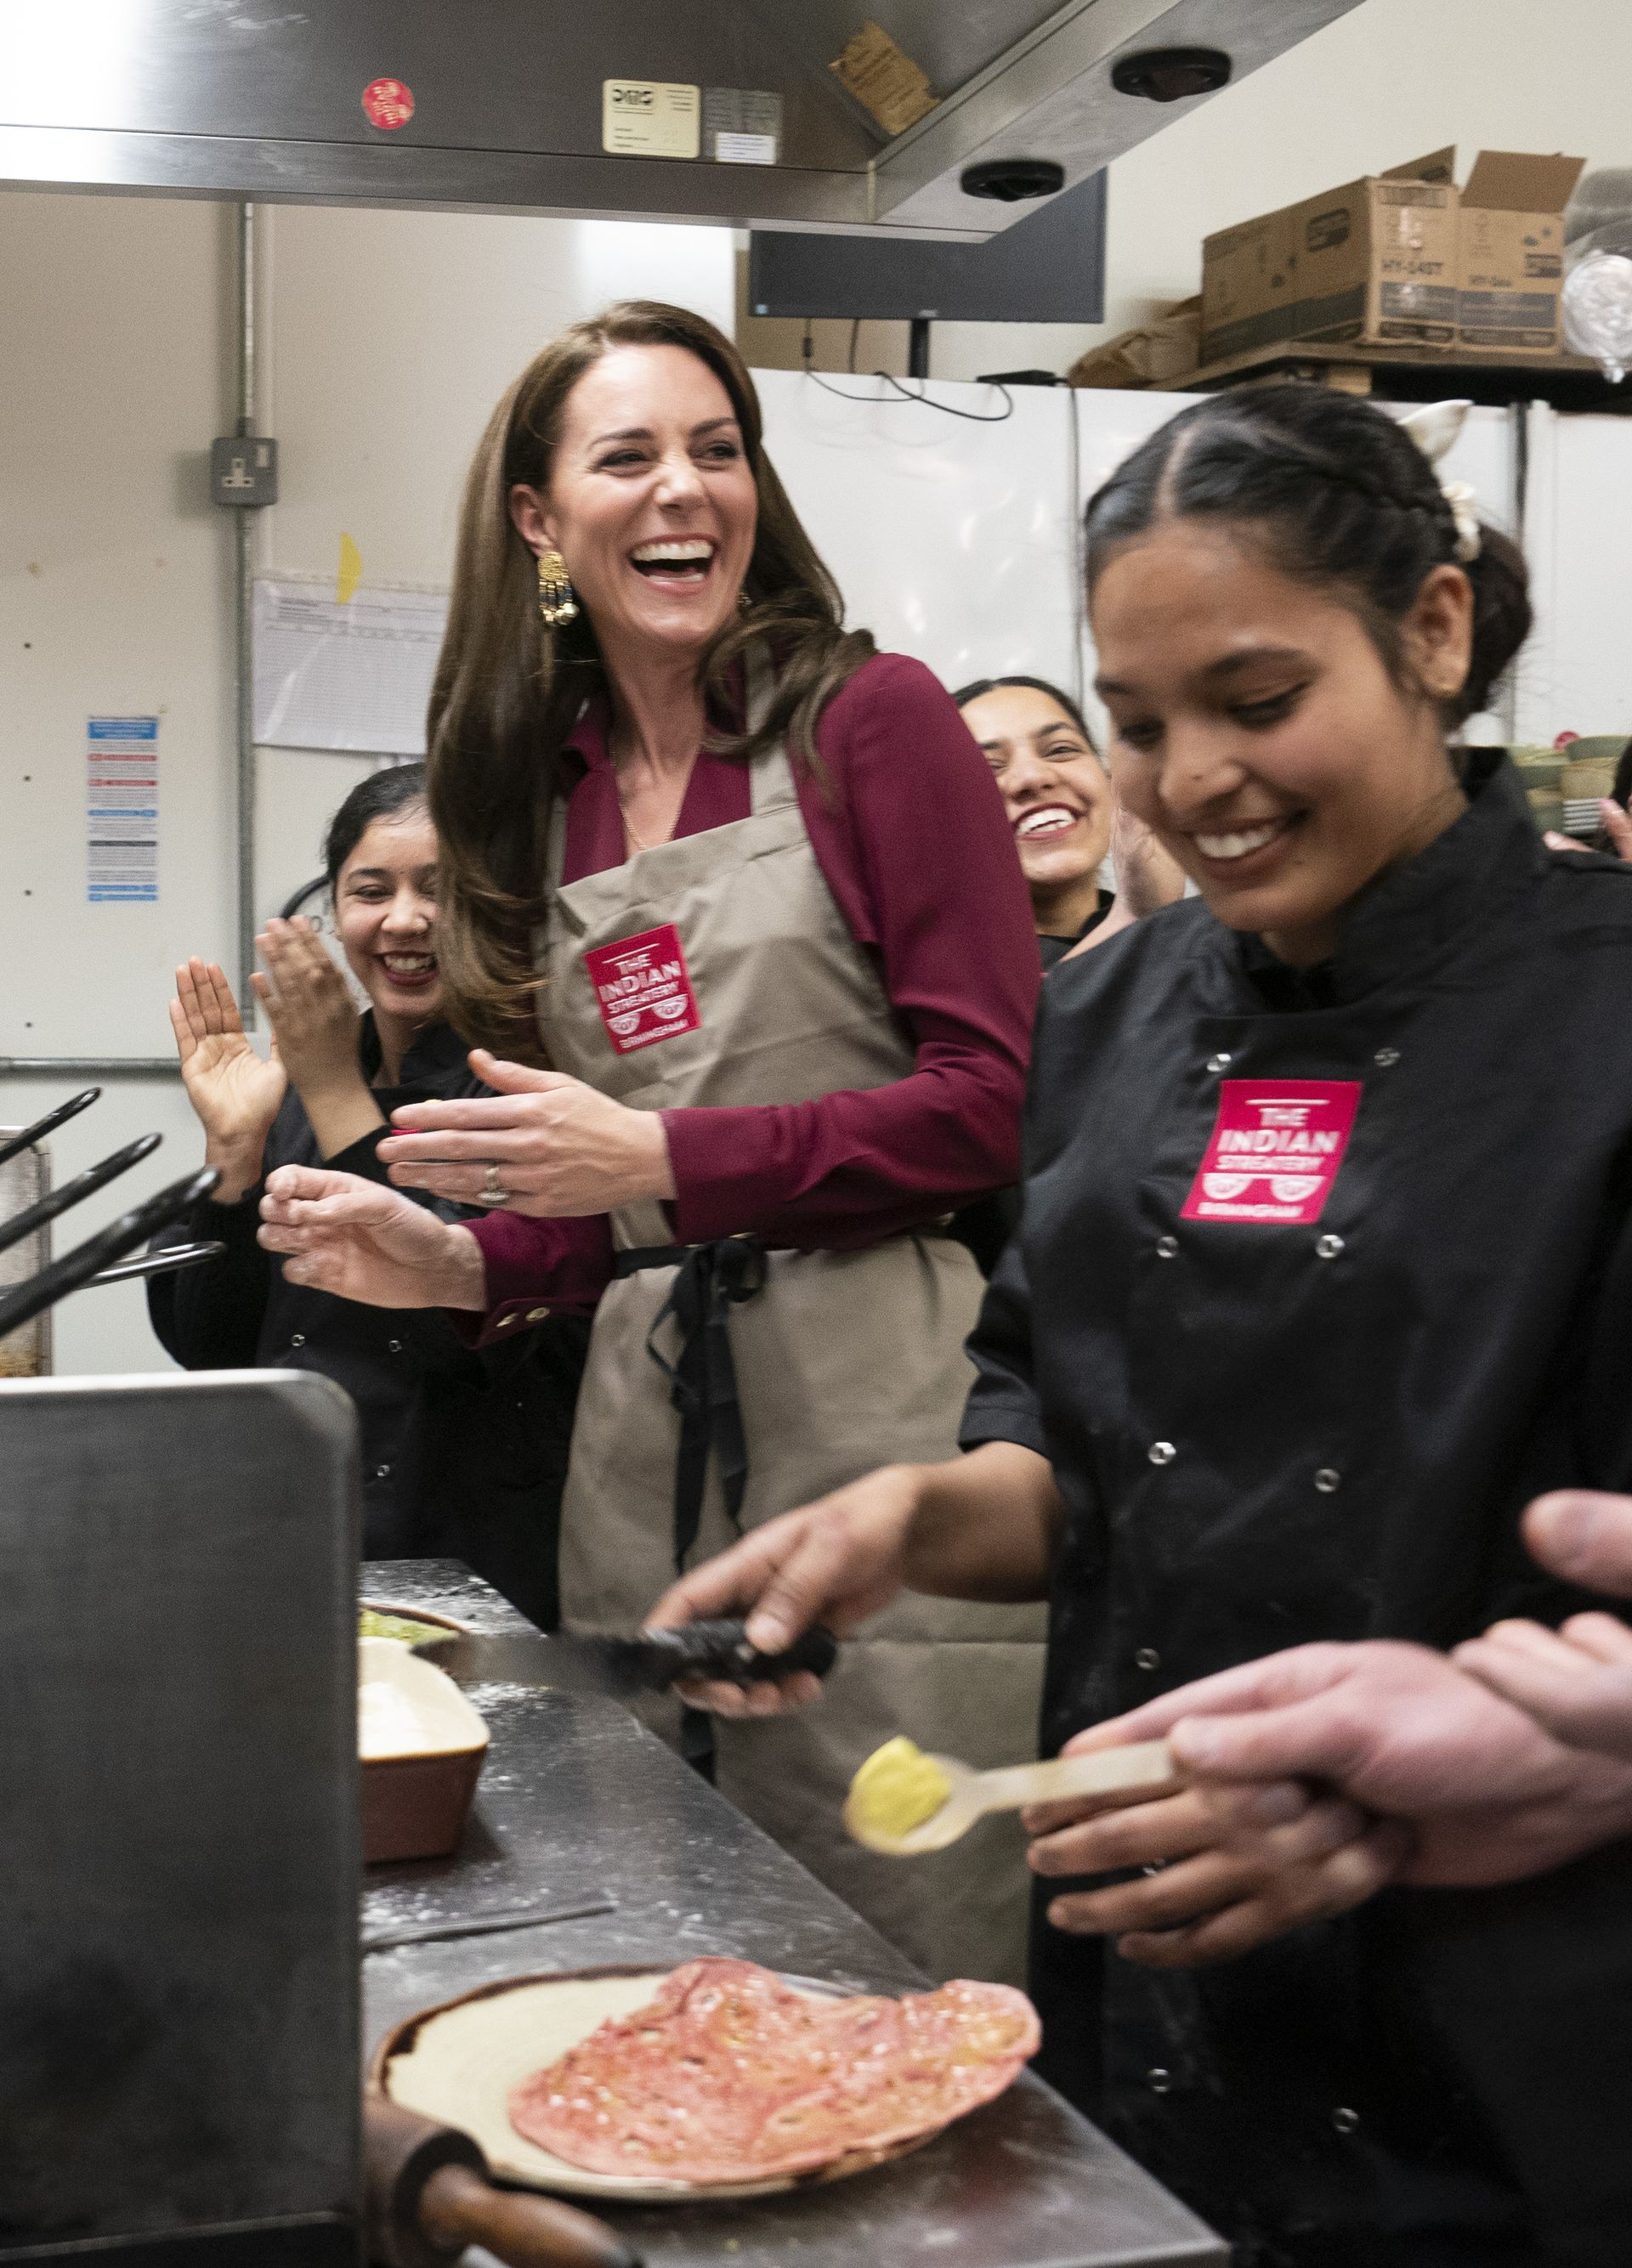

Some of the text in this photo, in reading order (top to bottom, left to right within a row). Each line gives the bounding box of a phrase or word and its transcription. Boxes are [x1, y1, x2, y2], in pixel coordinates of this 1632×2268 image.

[615, 953, 652, 974] THE
[598, 961, 682, 1002] INDIAN
[1259, 1106, 1311, 1127] THE
[1216, 1128, 1340, 1153] INDIAN
